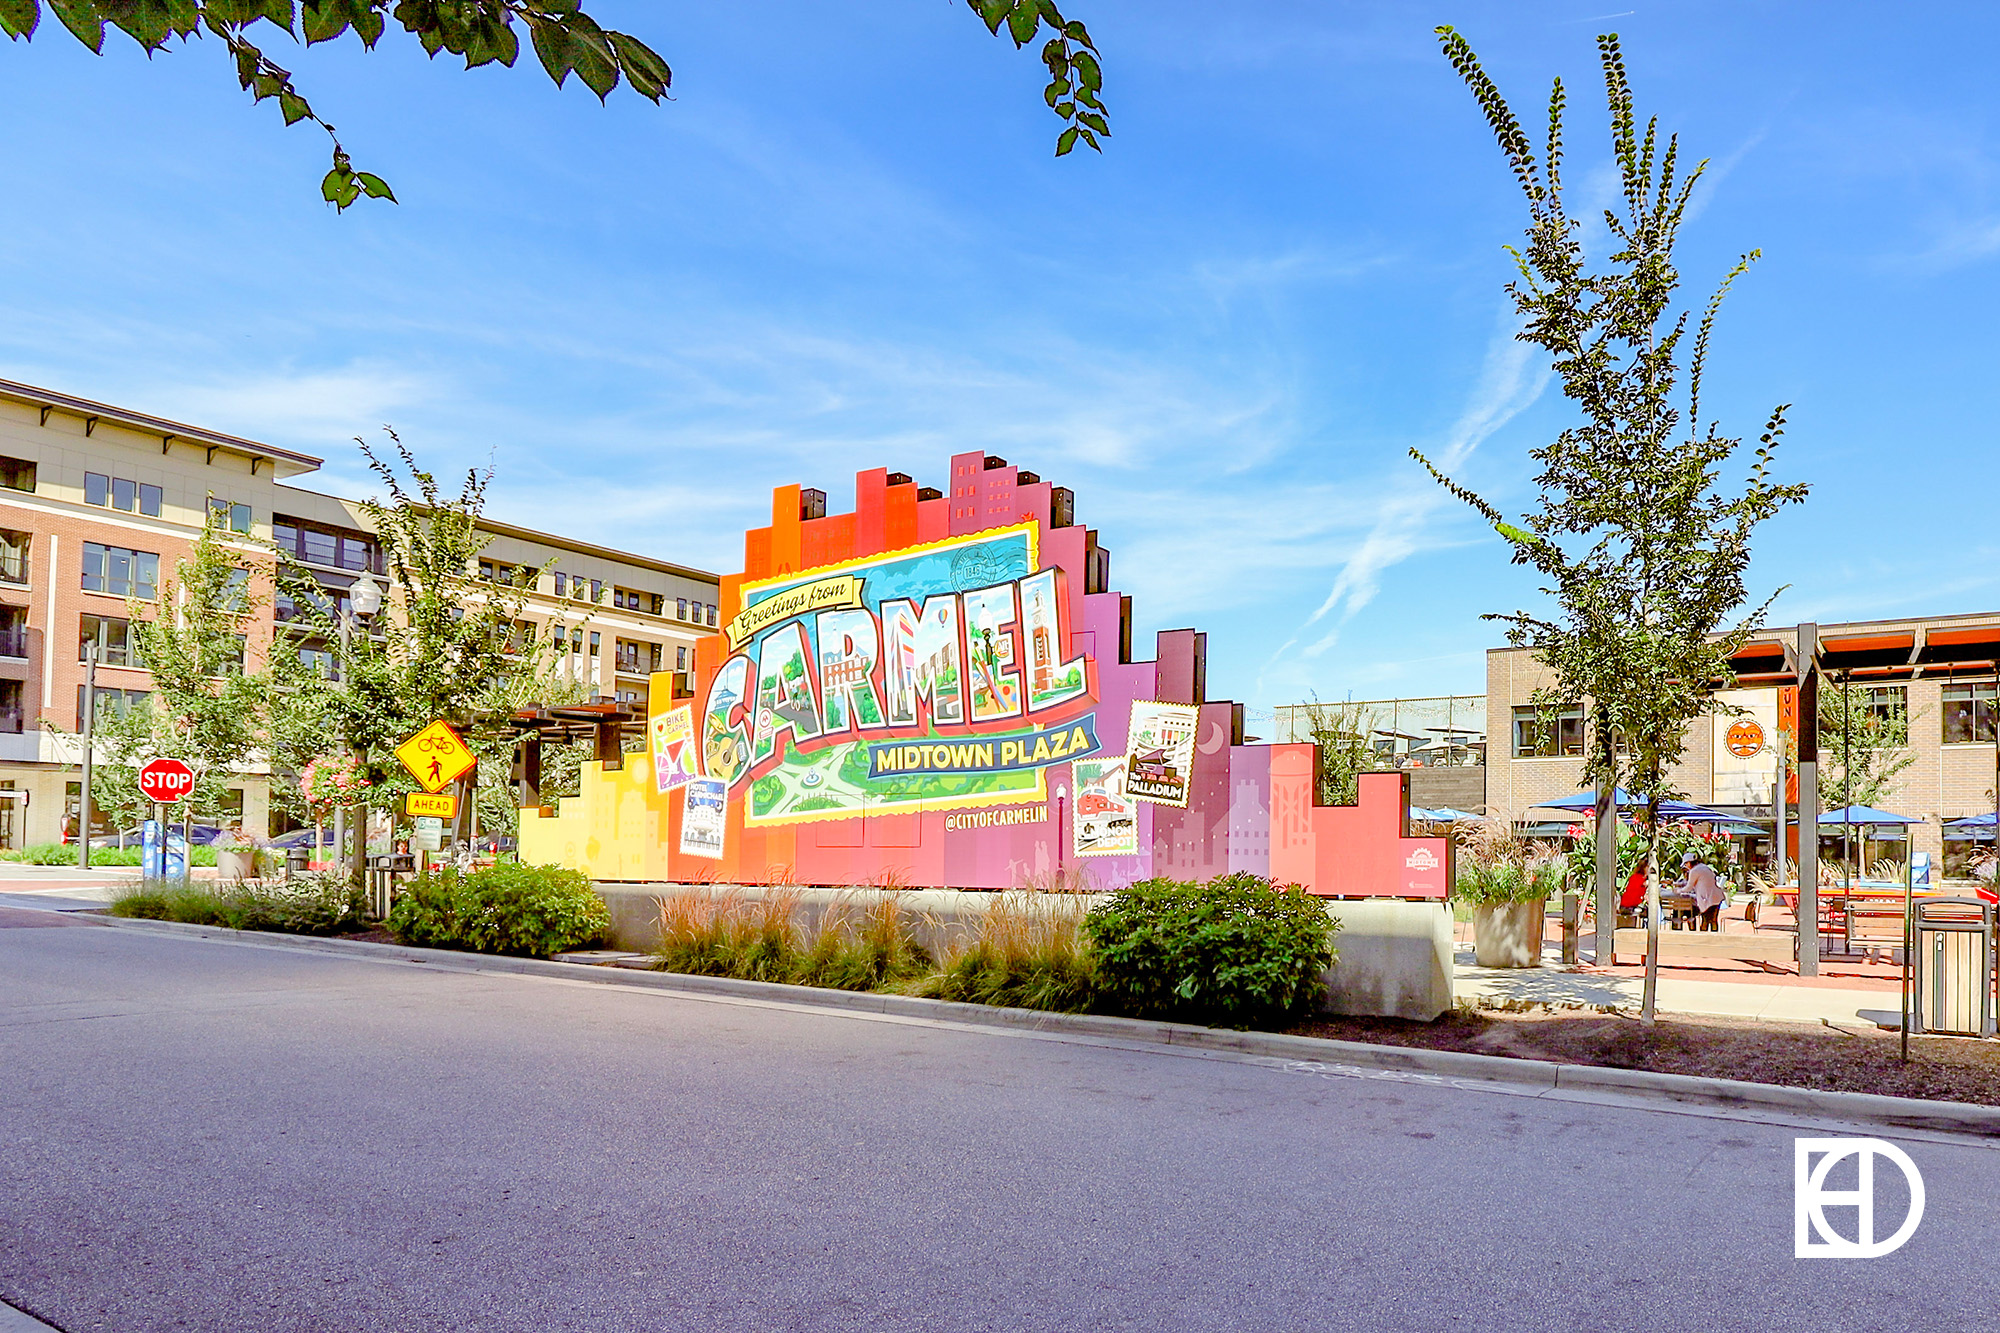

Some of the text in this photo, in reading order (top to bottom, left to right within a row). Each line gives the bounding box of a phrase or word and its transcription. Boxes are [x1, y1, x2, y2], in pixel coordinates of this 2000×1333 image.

[965, 565, 980, 578] 1846
[739, 583, 847, 635] Greetings from
[702, 566, 1088, 787] CARMEL
[666, 712, 684, 726] BIKE
[667, 721, 689, 734] CARMEL
[877, 726, 1090, 773] MIDTOWN PLAZA
[143, 771, 191, 790] STOP
[1129, 772, 1142, 781] The
[690, 783, 707, 792] HOTEL
[1127, 781, 1183, 798] PALLADIUM
[413, 799, 449, 811] AHEAD
[945, 806, 1048, 832] @CITYOFCARMELIN
[1097, 837, 1132, 848] DEPOT
